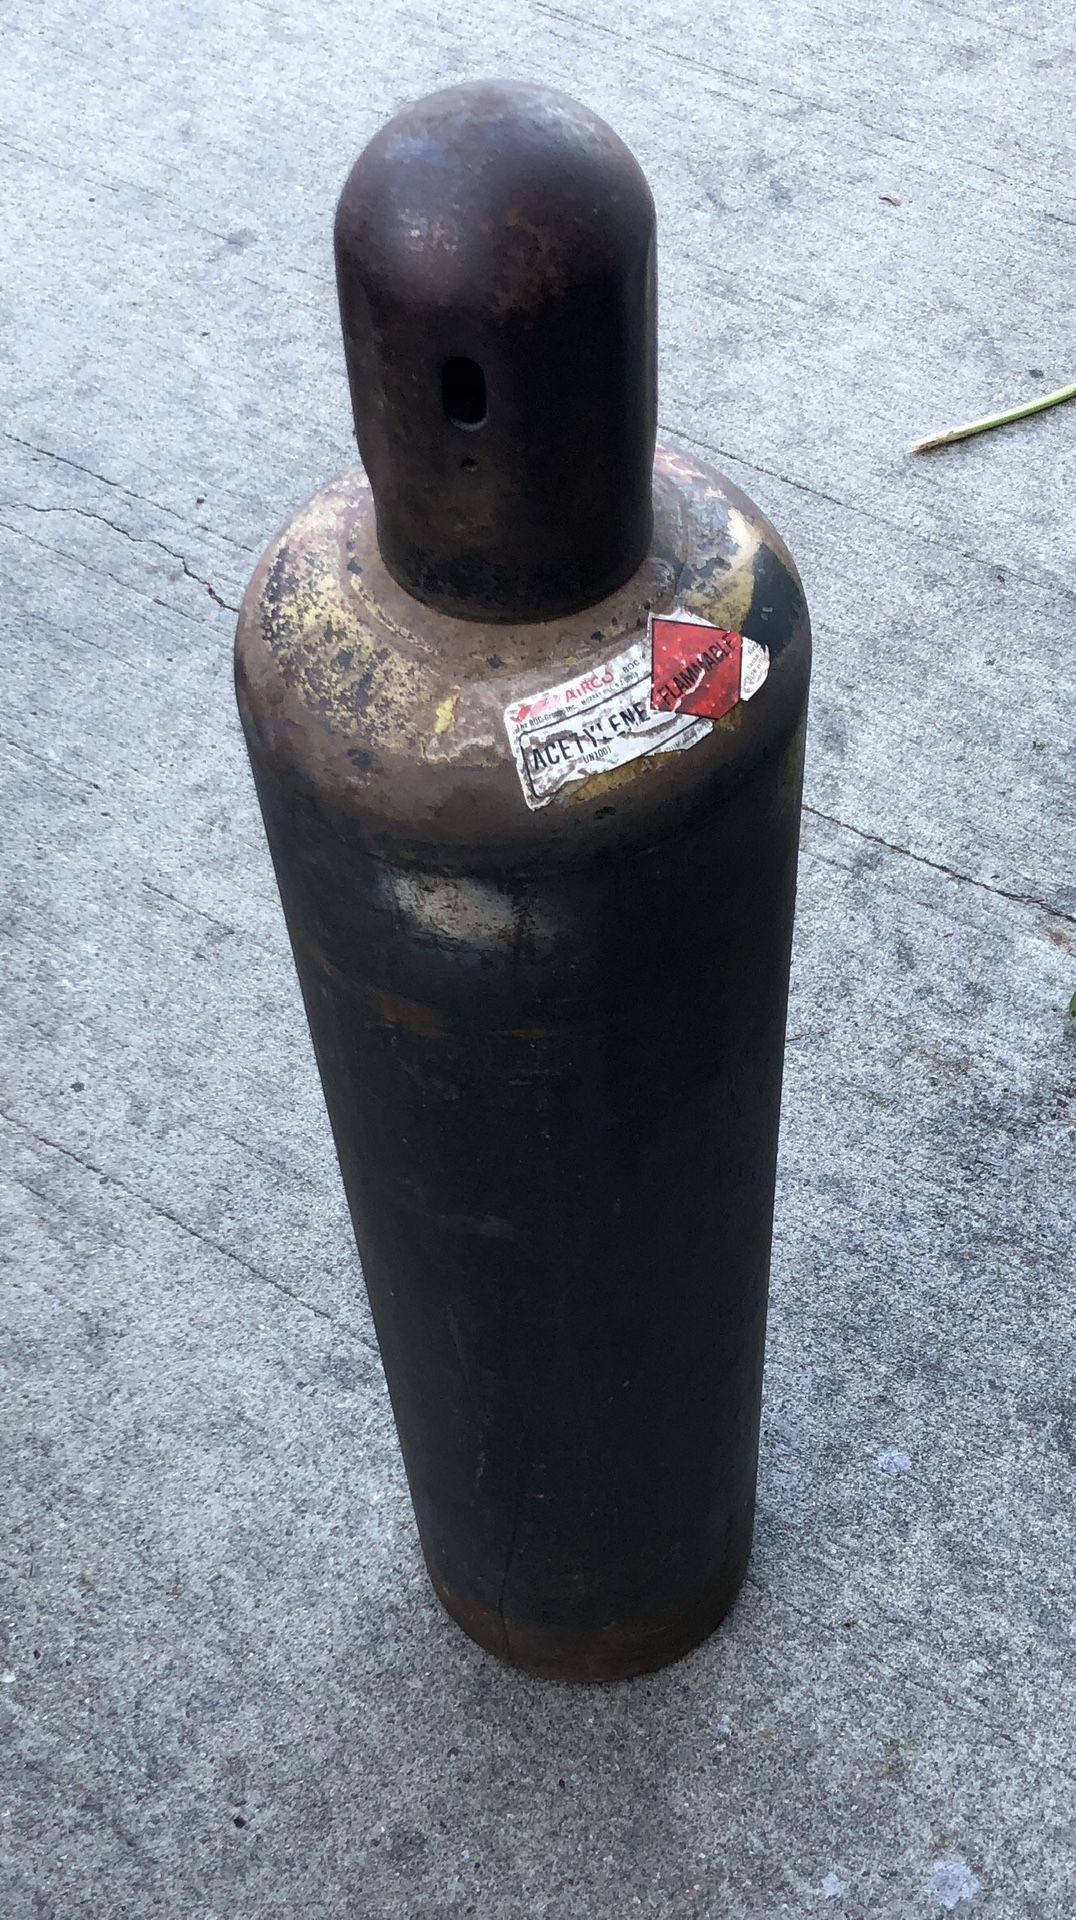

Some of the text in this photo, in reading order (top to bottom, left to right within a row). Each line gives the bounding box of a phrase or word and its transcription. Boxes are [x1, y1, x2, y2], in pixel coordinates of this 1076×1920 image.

[622, 659, 640, 673] BOC
[657, 632, 735, 706] FLAMMABLE
[565, 671, 614, 702] AIRCO
[533, 702, 651, 770] ACETYLENE
[583, 745, 612, 763] UN1001
